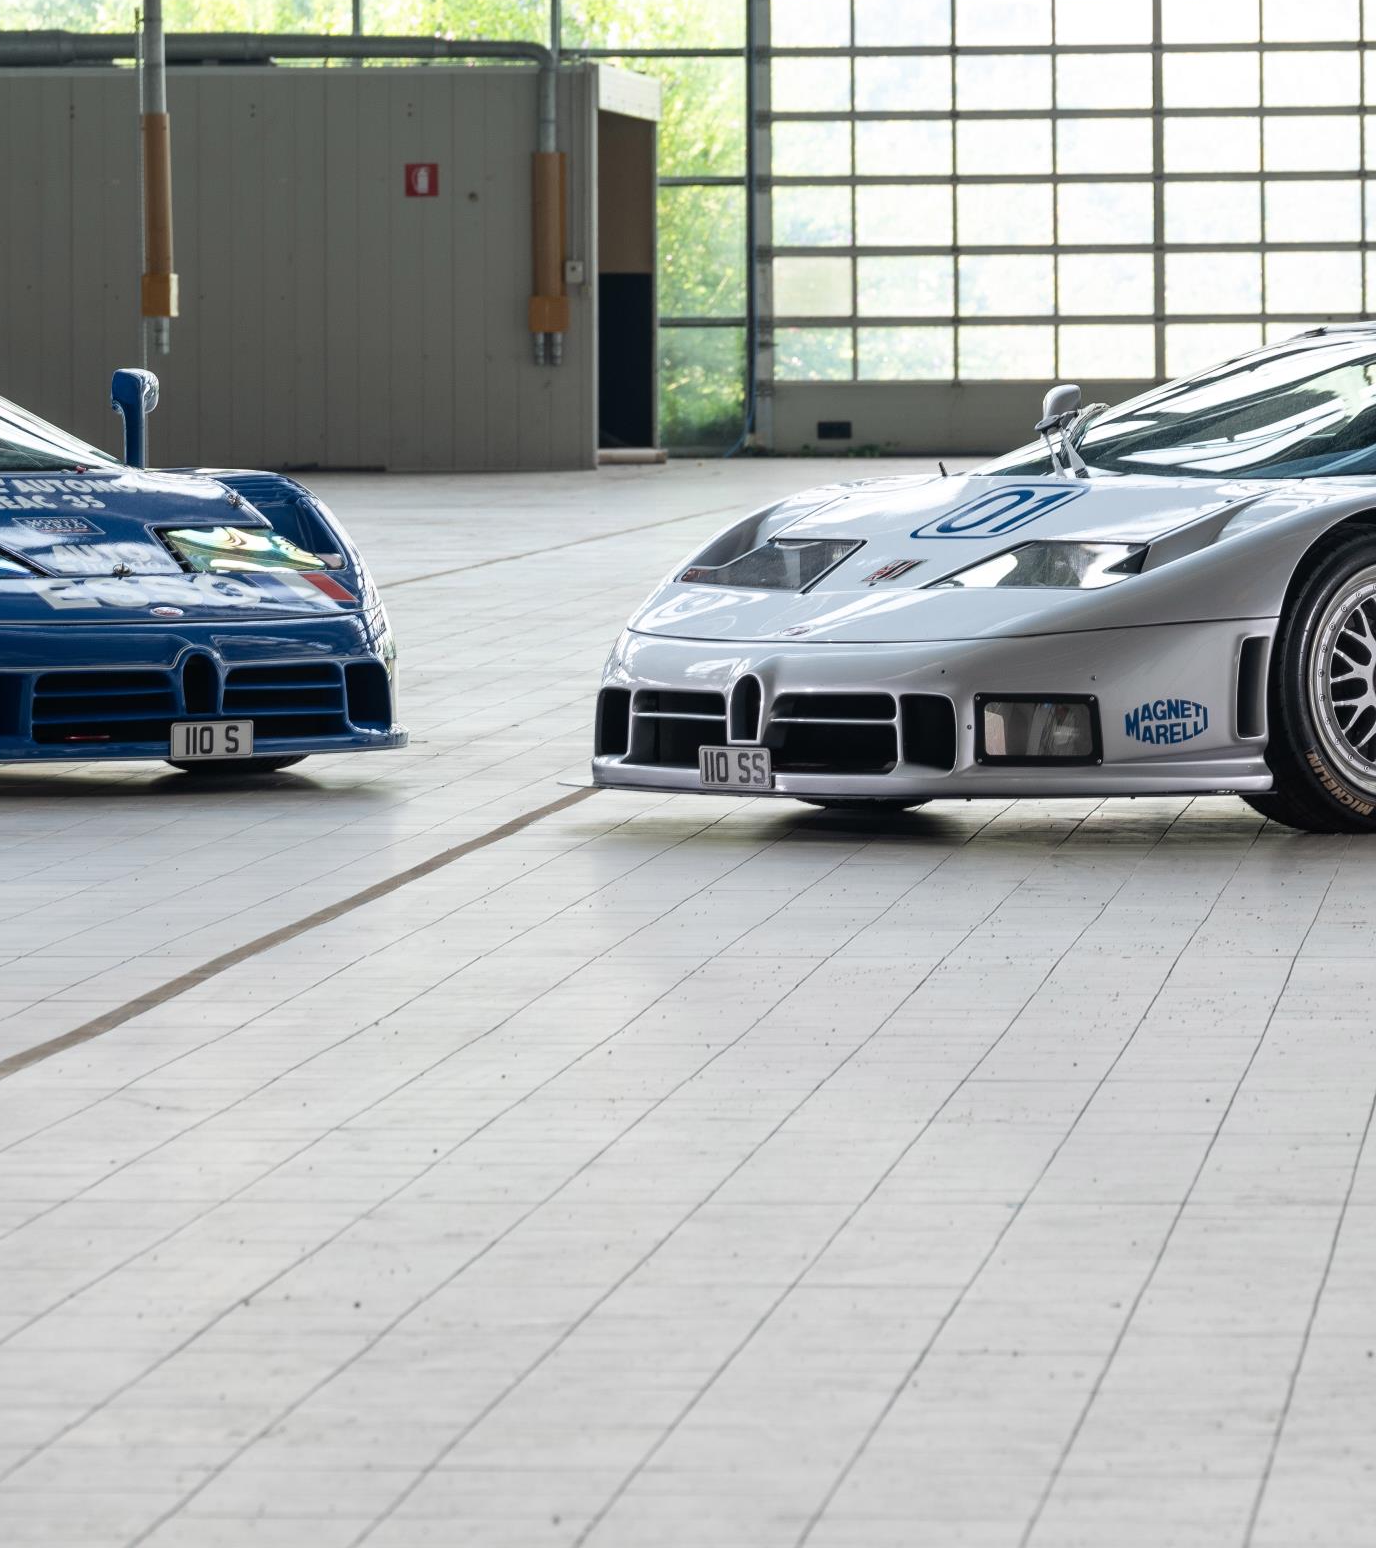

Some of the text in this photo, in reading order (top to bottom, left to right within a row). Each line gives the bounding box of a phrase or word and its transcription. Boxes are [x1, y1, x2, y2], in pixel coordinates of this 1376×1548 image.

[61, 494, 106, 509] 35
[936, 489, 1075, 534] 01
[23, 573, 261, 611] ESSO
[1125, 699, 1208, 733] MAGNETI
[1125, 714, 1208, 744] MARELLI
[185, 725, 239, 755] 110 S
[704, 751, 765, 784] 110 SS
